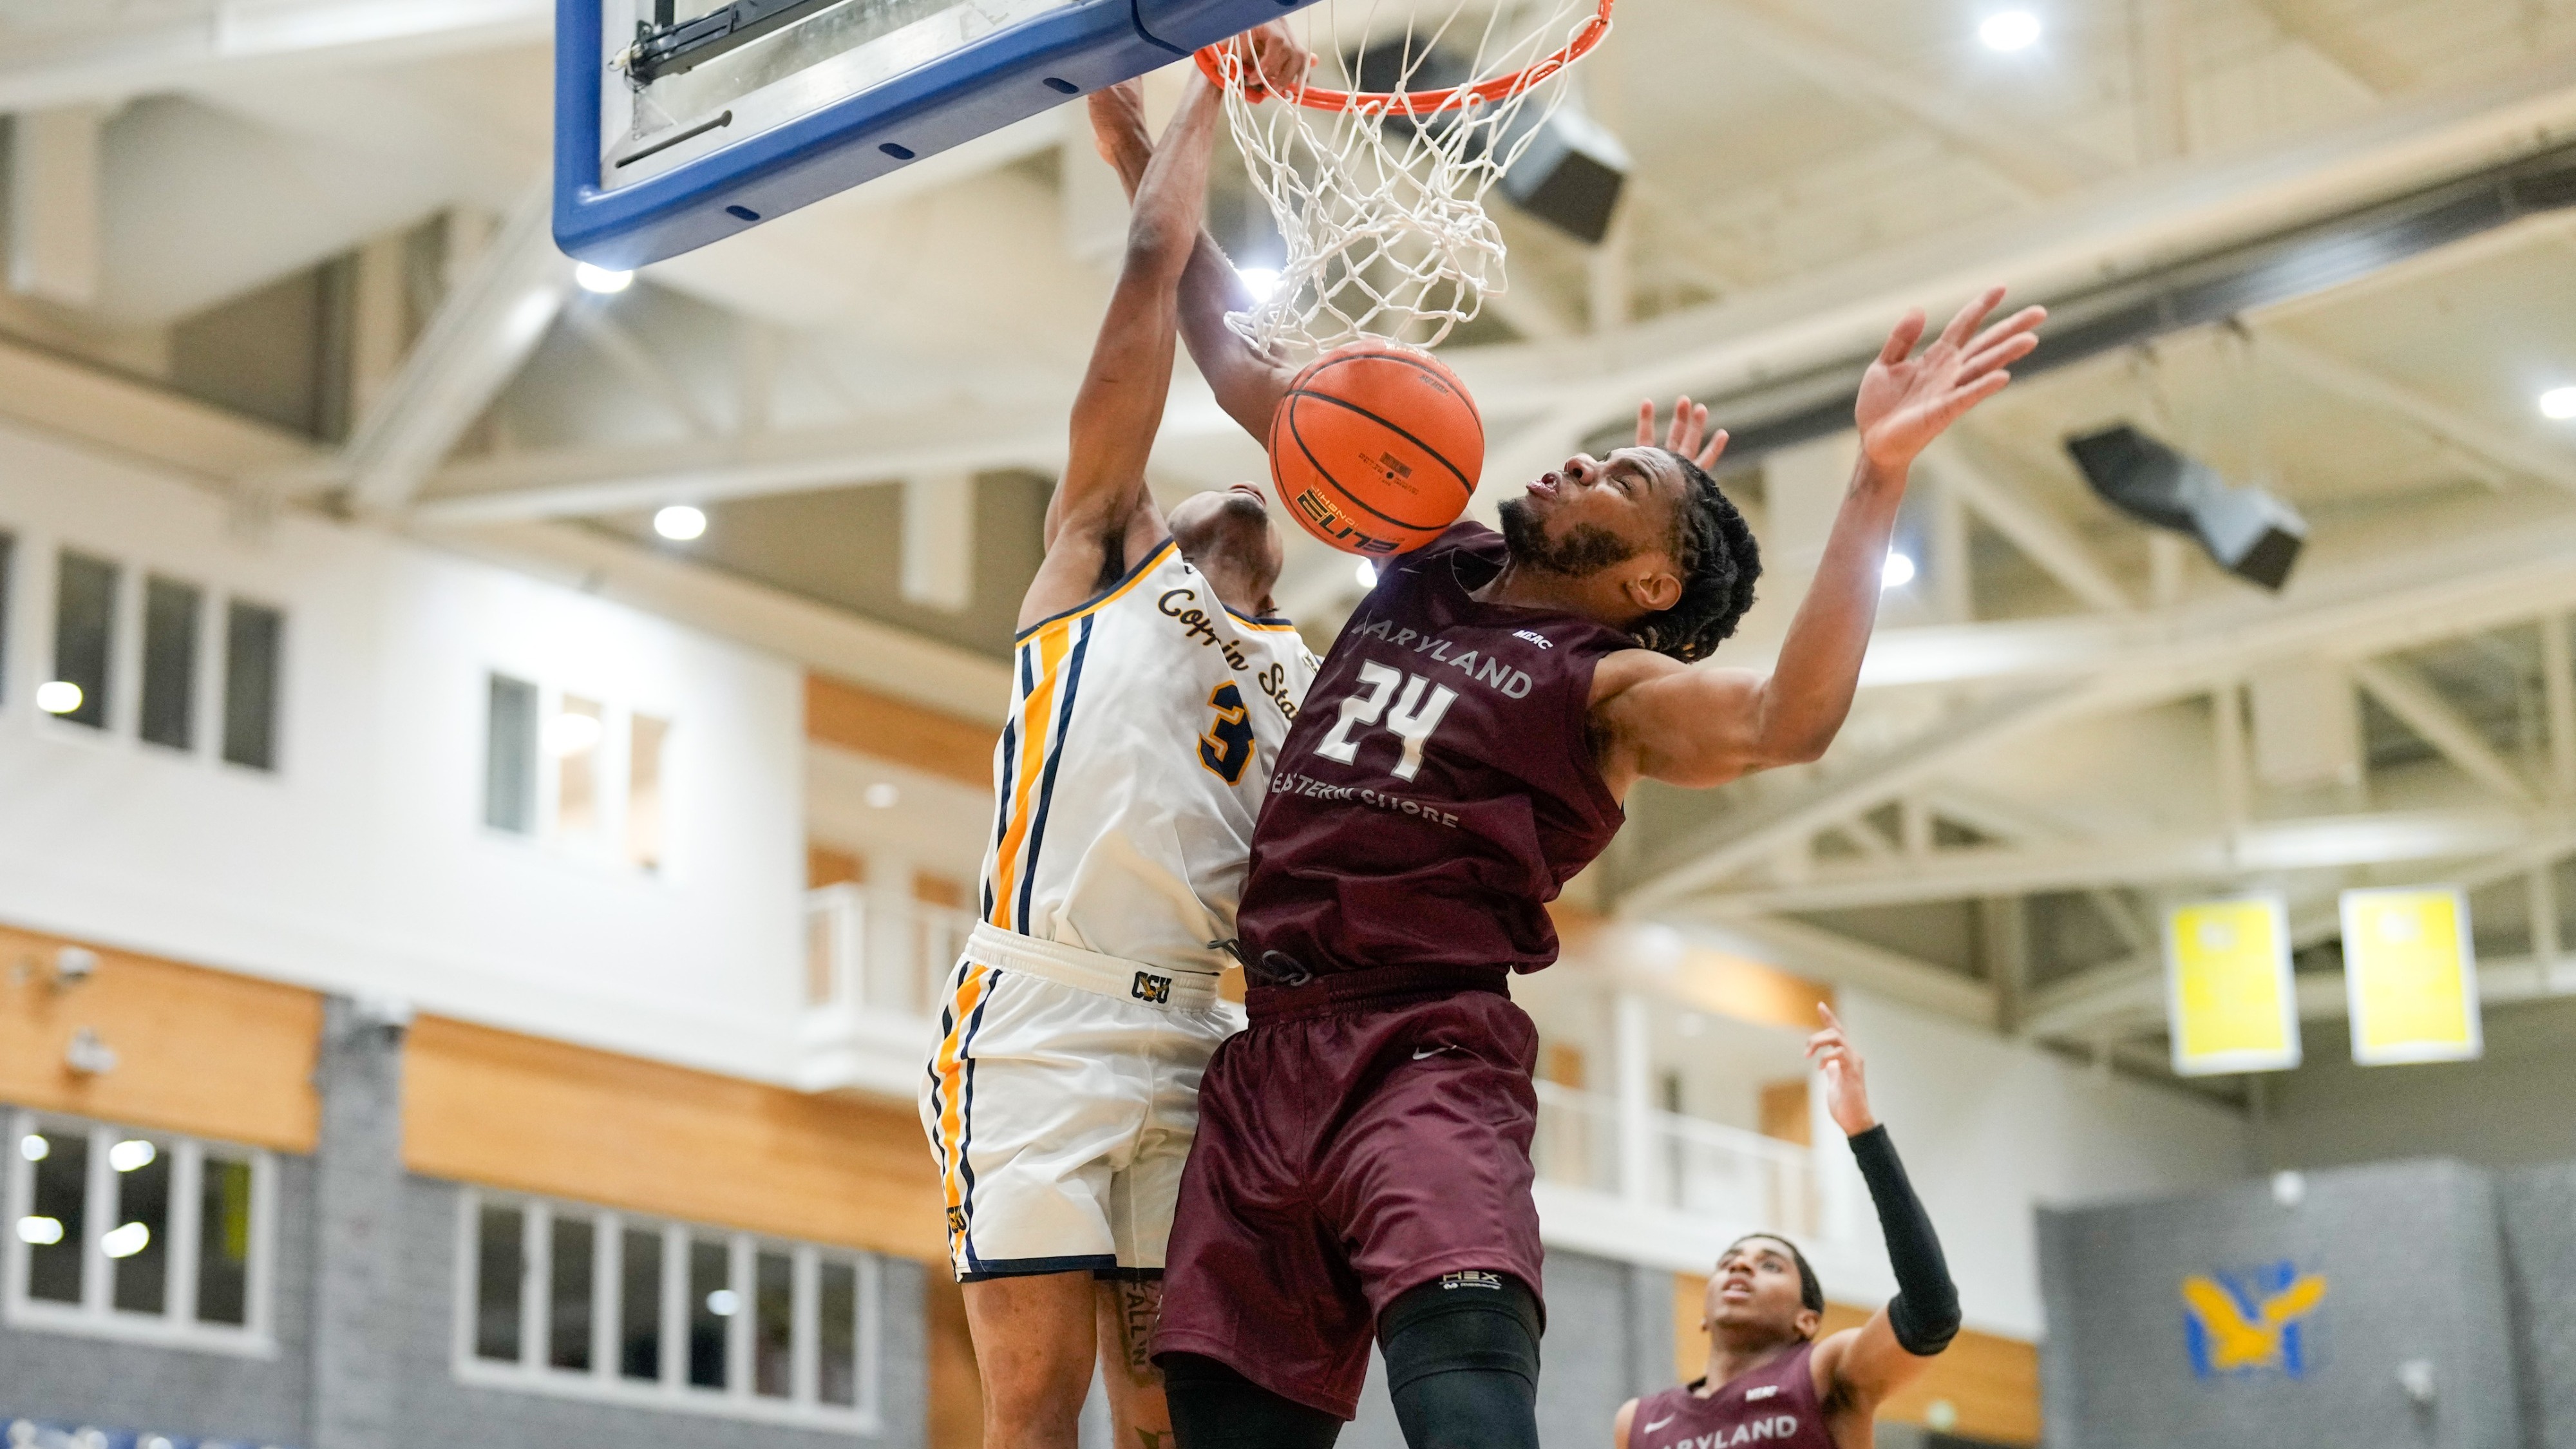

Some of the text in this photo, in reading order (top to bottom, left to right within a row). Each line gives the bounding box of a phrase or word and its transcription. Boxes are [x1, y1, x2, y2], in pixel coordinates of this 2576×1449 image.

[1296, 488, 1400, 554] ELITE
[1511, 629, 1553, 650] MEAC
[1197, 679, 1256, 786] 3
[1313, 658, 1459, 783] 24
[1131, 971, 1172, 1004] CSU
